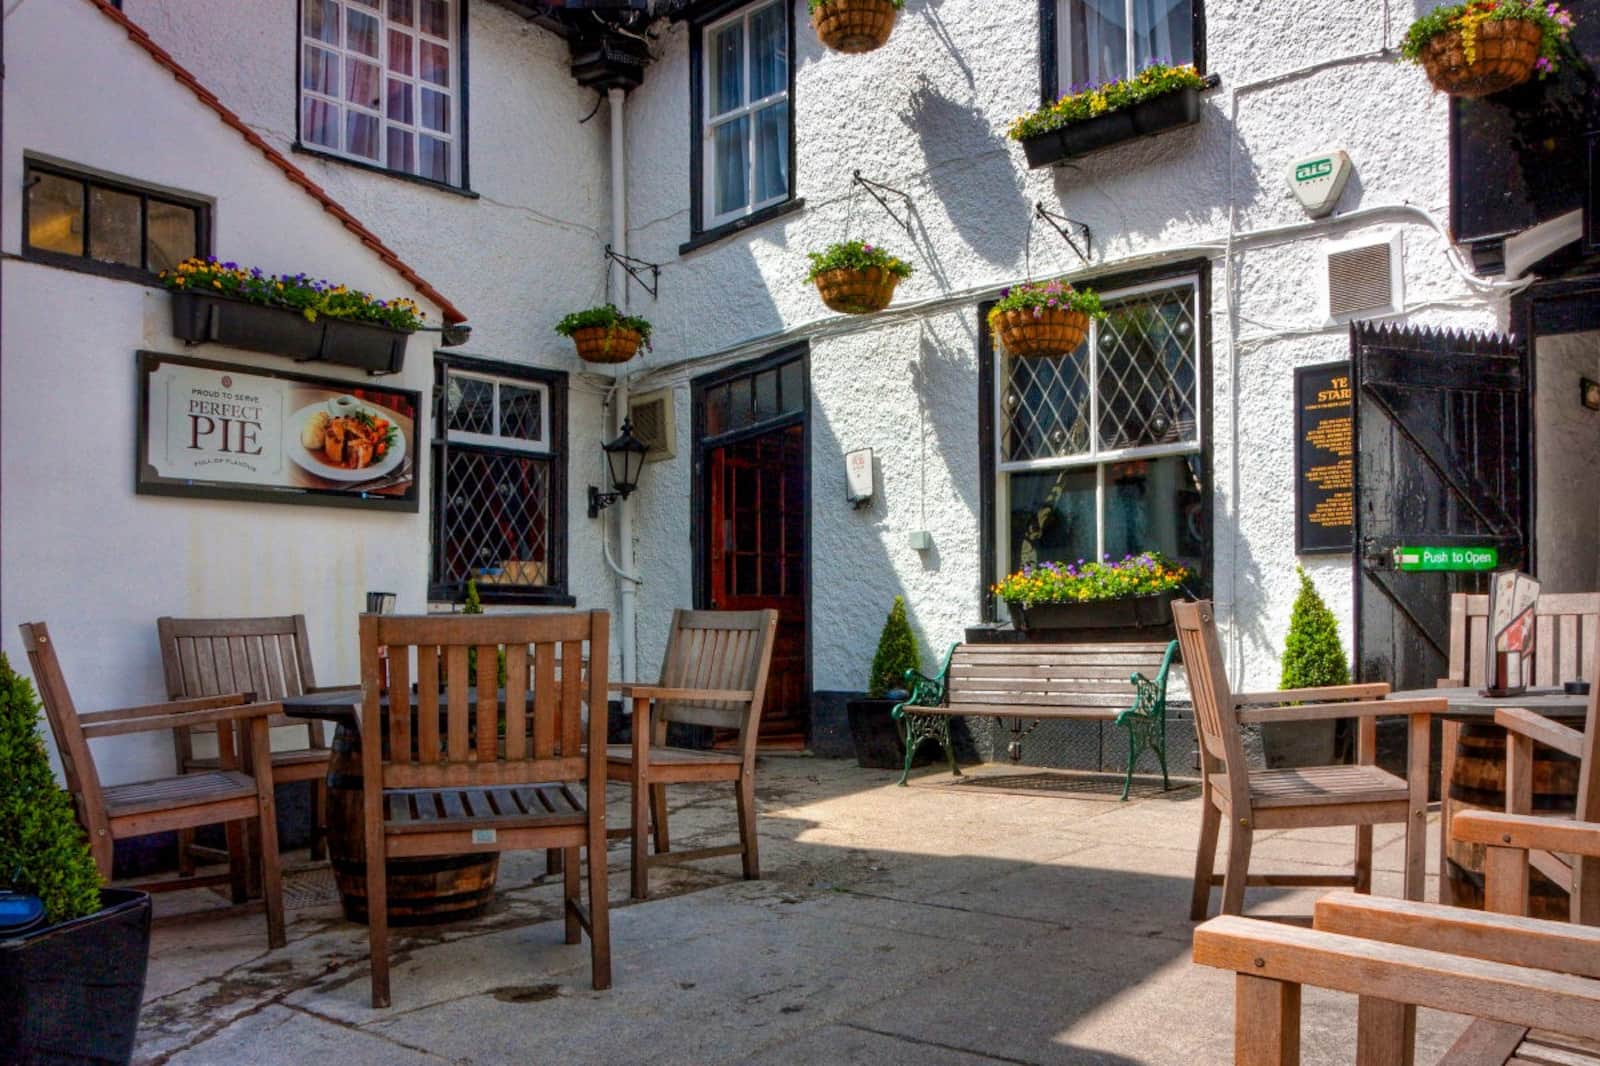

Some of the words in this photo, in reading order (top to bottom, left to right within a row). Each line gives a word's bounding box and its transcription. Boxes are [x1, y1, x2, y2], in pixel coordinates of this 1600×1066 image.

[191, 388, 220, 398] PROUD
[222, 391, 233, 400] TO
[234, 393, 260, 403] SERVE
[188, 399, 263, 420] PERFECT
[187, 414, 263, 455] PIE
[1423, 551, 1449, 564] Push
[1452, 551, 1464, 564] to
[1465, 550, 1492, 567] Open
